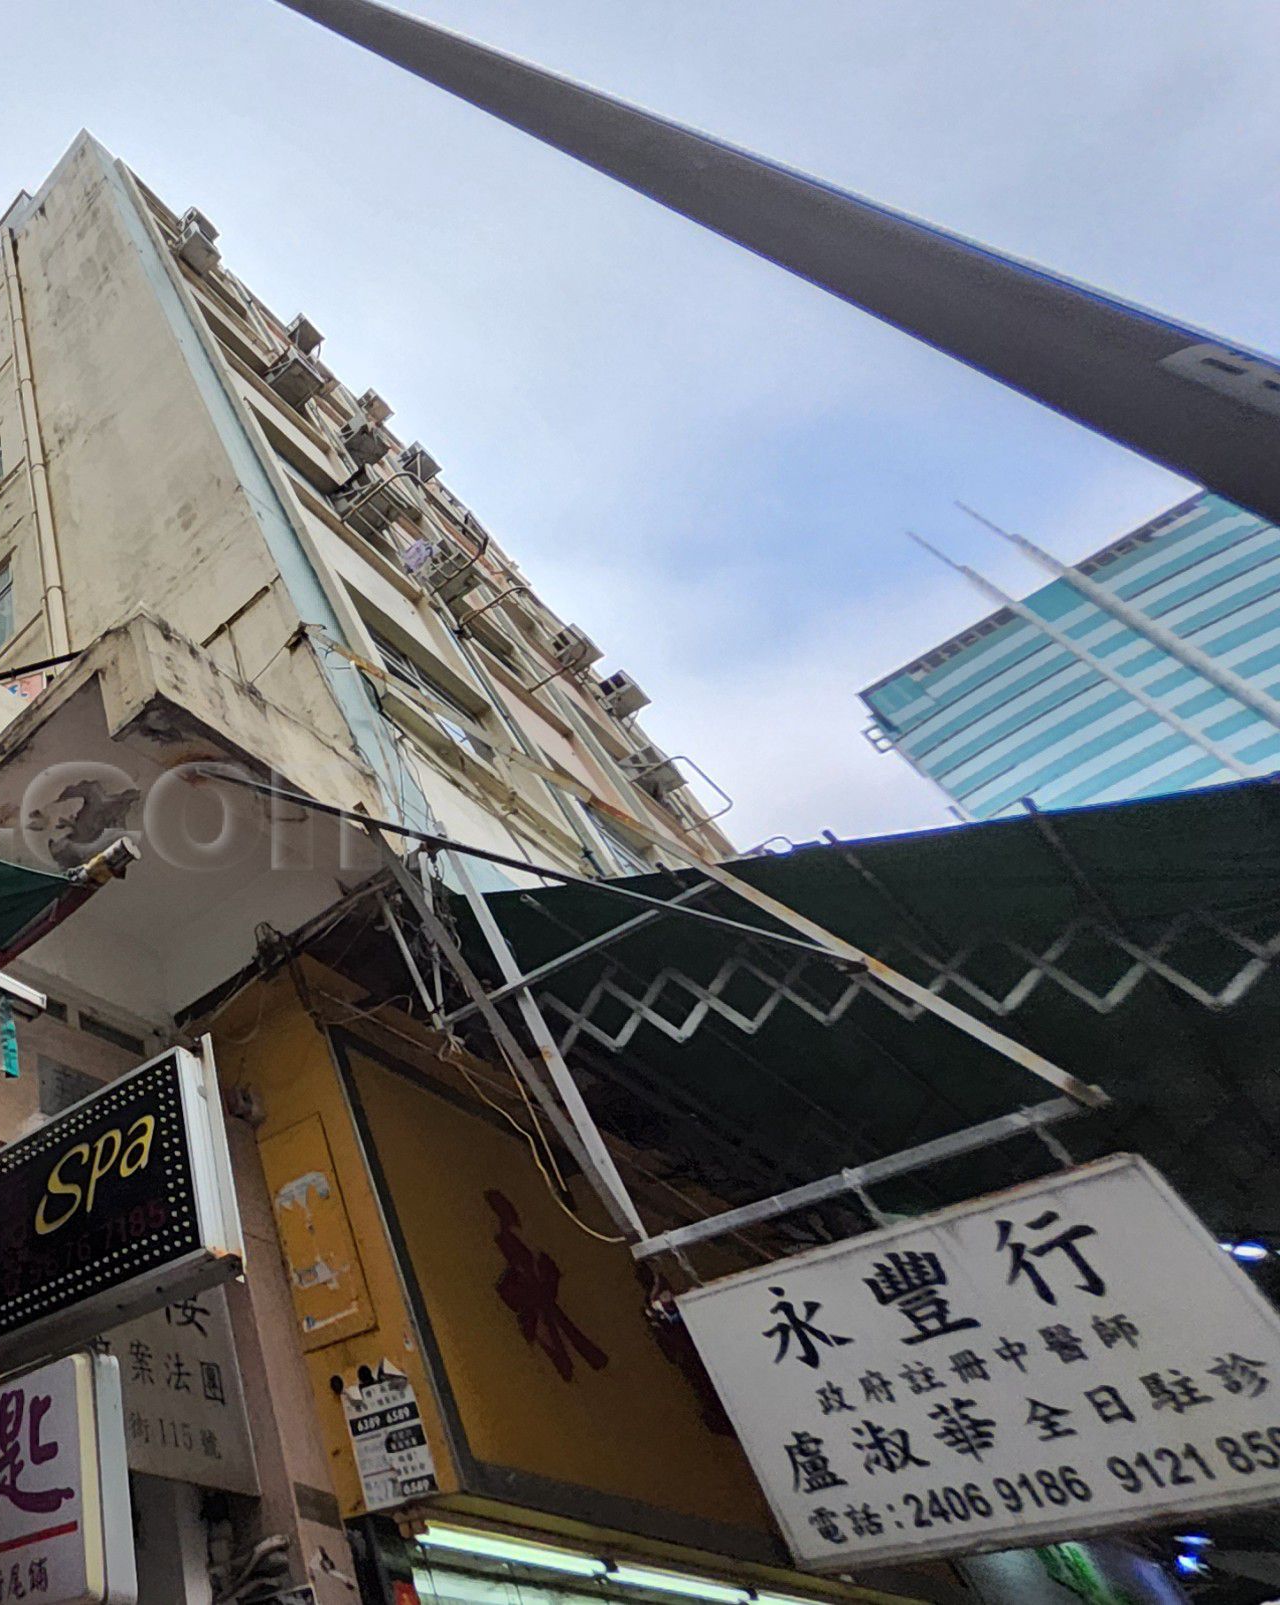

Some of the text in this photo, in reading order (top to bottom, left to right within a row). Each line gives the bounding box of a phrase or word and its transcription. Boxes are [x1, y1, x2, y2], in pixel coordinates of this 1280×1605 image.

[35, 1114, 155, 1235] Spa
[763, 1209, 1107, 1370] 永豐行
[815, 1313, 1140, 1415] 政府註冊中醫師
[903, 1483, 994, 1528] 2406
[993, 1465, 1092, 1513] 9186
[1107, 1442, 1217, 1493] 9121
